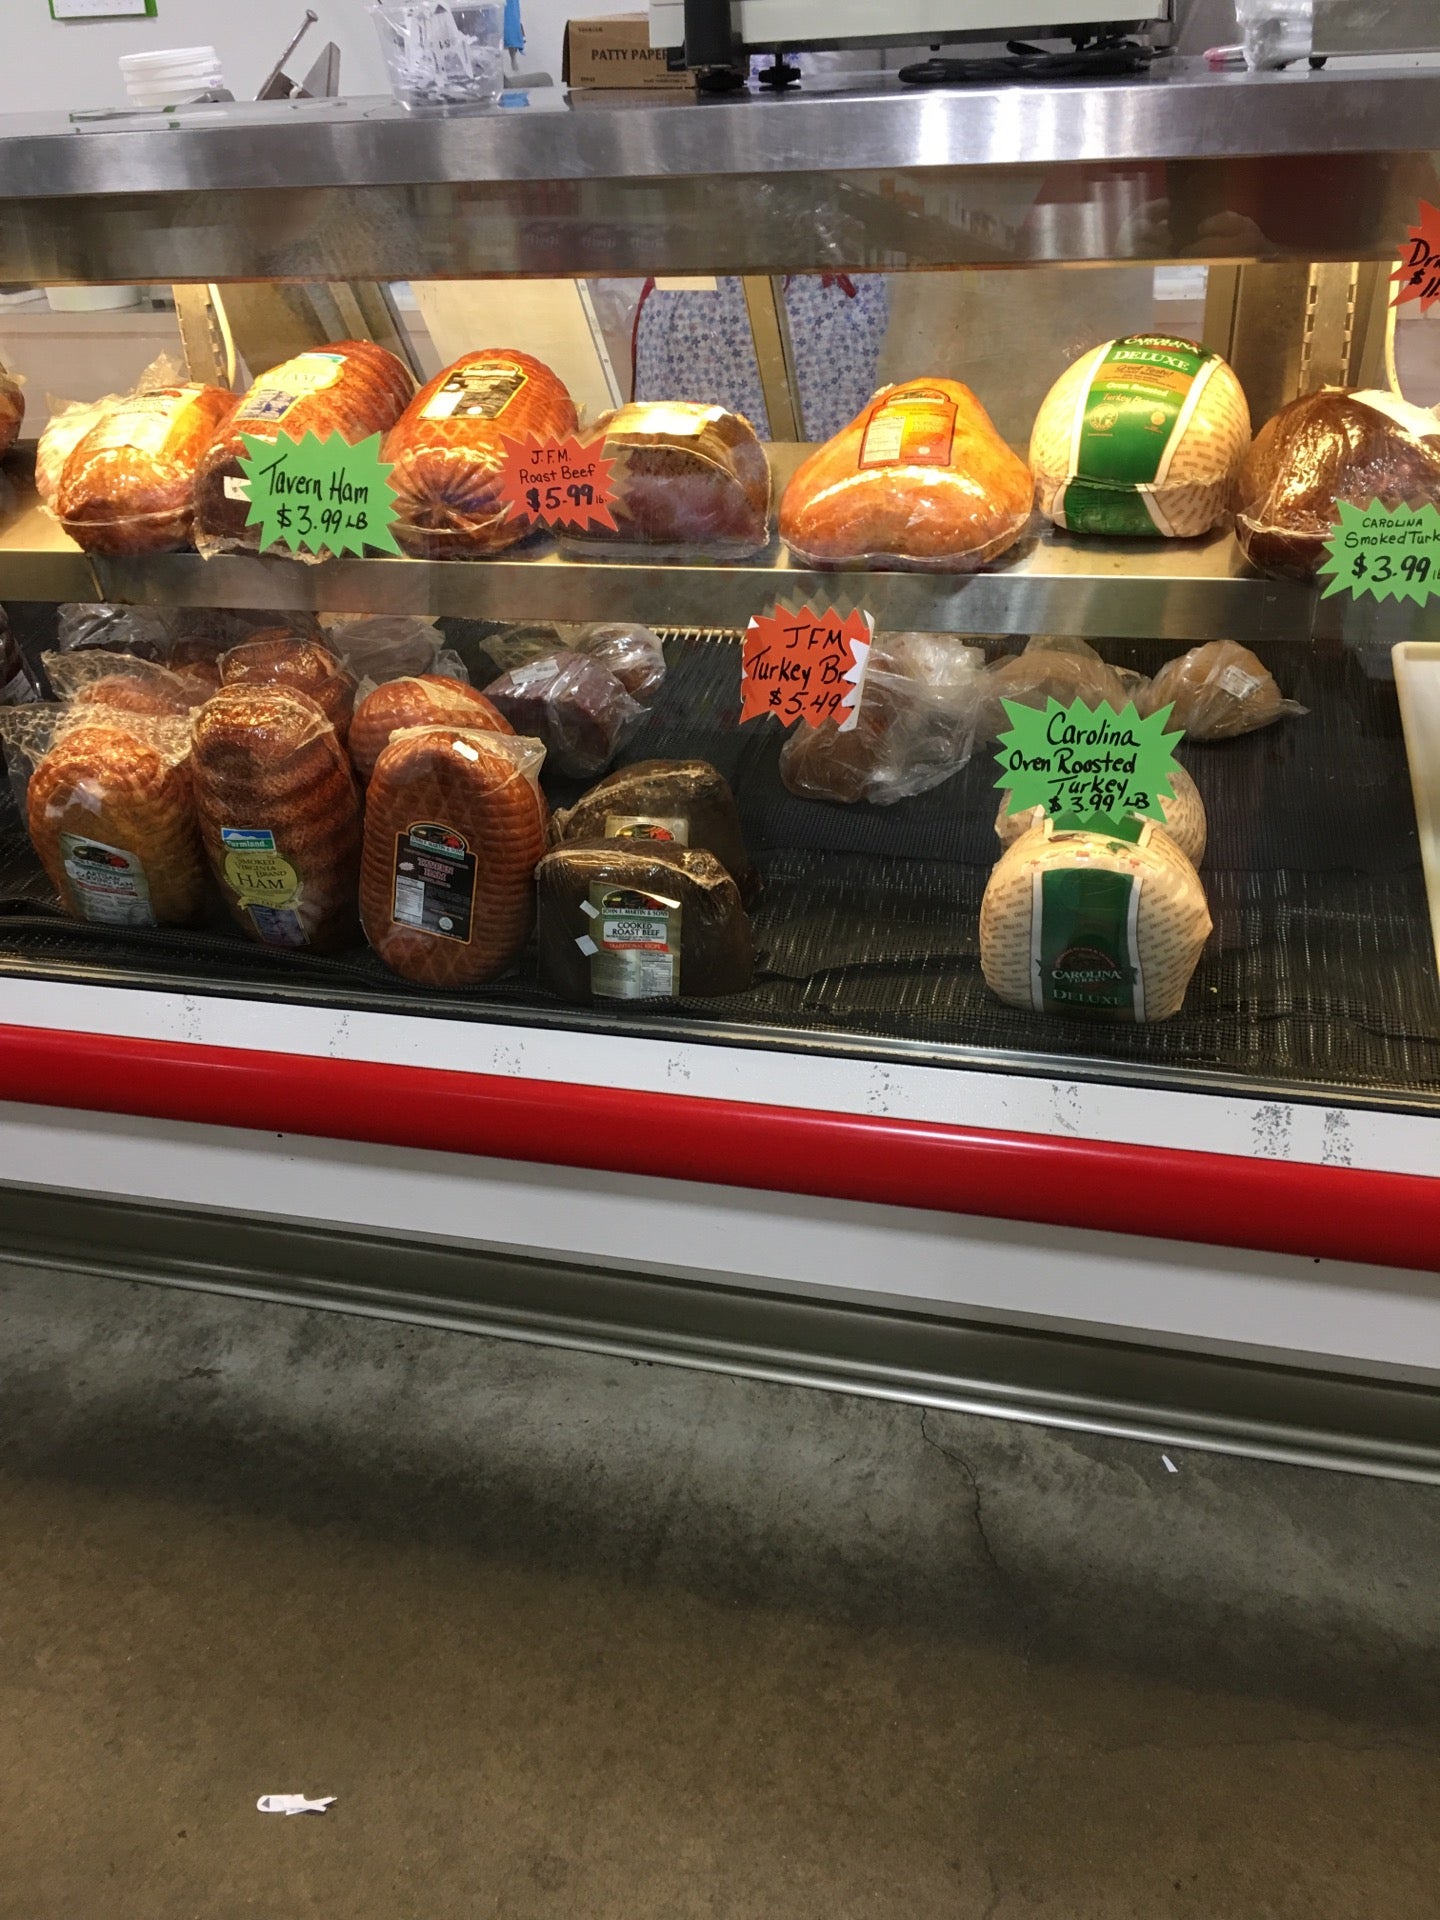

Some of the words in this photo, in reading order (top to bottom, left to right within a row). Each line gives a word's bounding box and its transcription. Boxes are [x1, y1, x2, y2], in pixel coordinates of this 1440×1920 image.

[592, 49, 628, 60] PATTY
[1124, 337, 1201, 355] CAROLINA
[1112, 350, 1190, 371] DELUXE
[259, 453, 323, 501] Tavern
[329, 467, 369, 505] Ham
[519, 468, 557, 484] Roast
[561, 463, 596, 480] Beef
[526, 483, 594, 512] $5.99
[277, 503, 343, 535] $3.99
[345, 511, 369, 530] LB
[1362, 517, 1423, 529] CAROLINA
[1344, 531, 1407, 549] Smoked
[746, 645, 812, 690] Turkey
[1047, 711, 1141, 748] Carolina
[1009, 749, 1051, 772] Oven
[1053, 747, 1138, 774] Roasted
[1048, 775, 1129, 800] Turkey
[1123, 792, 1150, 809] LB
[236, 873, 284, 889] HAM
[612, 928, 640, 936] ROAST
[642, 929, 660, 937] BEEF
[617, 922, 653, 930] COOKED
[1051, 969, 1122, 980] CAROLINA
[1052, 989, 1120, 1005] DELUXE
